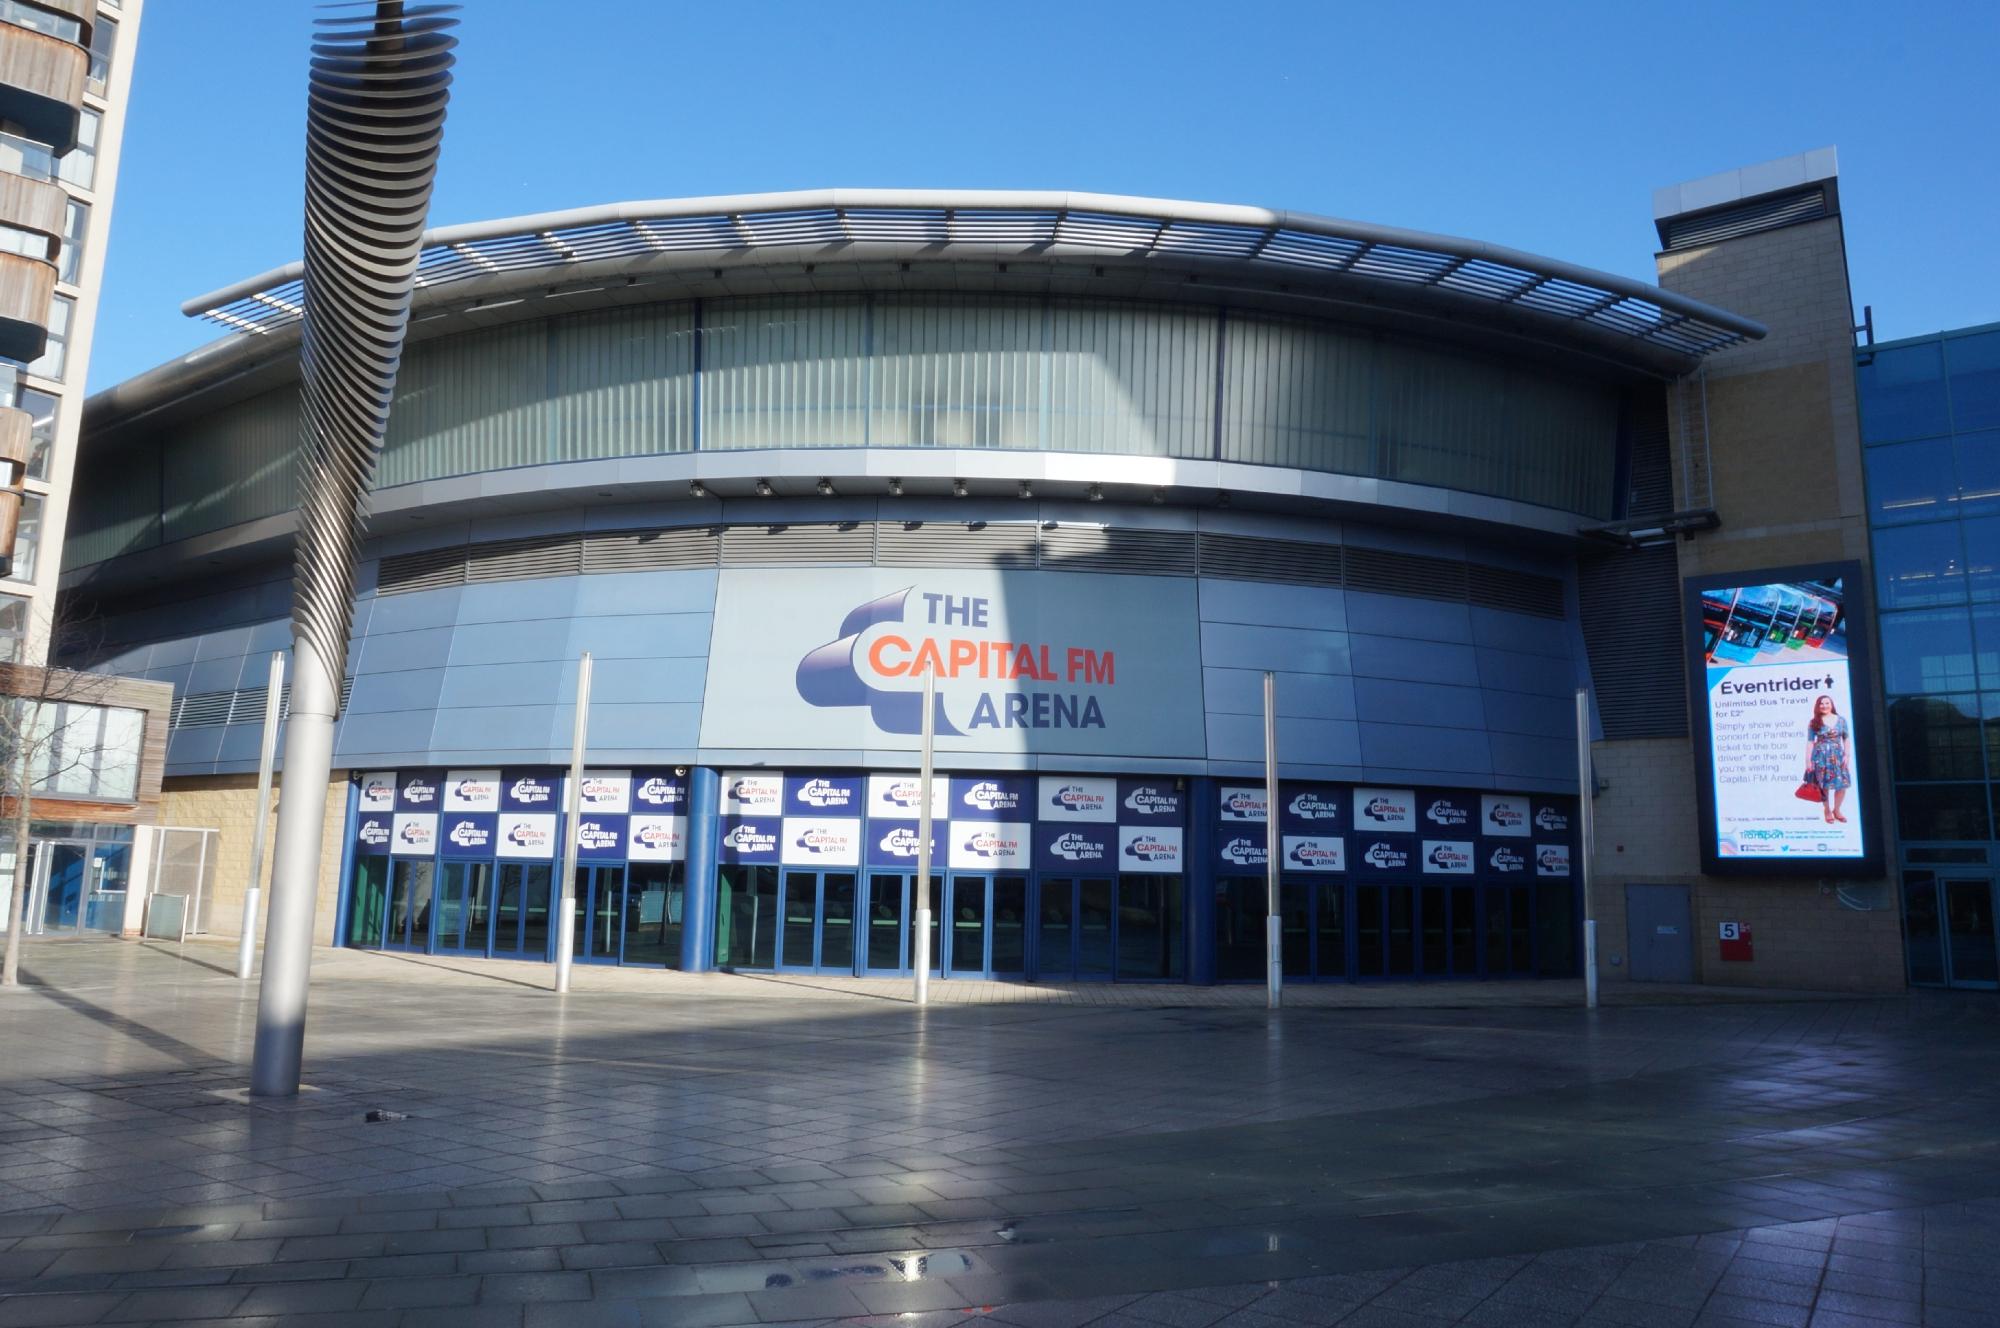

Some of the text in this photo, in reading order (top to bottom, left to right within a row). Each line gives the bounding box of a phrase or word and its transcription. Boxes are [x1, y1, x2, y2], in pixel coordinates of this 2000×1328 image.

[922, 592, 989, 628] THE
[868, 634, 1115, 685] CAPITAL FM
[1721, 677, 1821, 695] Eventrider
[1715, 700, 1757, 708] Unlimited
[1760, 698, 1777, 706] Bus
[967, 692, 1106, 729] ARENA
[1716, 722, 1745, 731] Simply
[1763, 731, 1804, 739] Panthers
[1770, 742, 1788, 750] bus
[1780, 752, 1797, 760] day
[739, 787, 768, 795] CAPITAL
[809, 788, 840, 797] CAPITAL
[895, 790, 921, 798] CAPIT
[976, 791, 1008, 800] CAPITAL
[1137, 796, 1168, 804] CAPITAL
[1233, 801, 1261, 809] CAPITAL
[1300, 801, 1328, 809] CAPITAL
[735, 834, 765, 843] CAPITAL
[976, 840, 1008, 848] CAPITAL
[1062, 841, 1094, 850] CAPITAL
[1080, 851, 1102, 859] ARENA
[1232, 847, 1261, 855] CAPITAL
[1301, 849, 1329, 857] CAPITAL
[1724, 923, 1735, 938] 5
